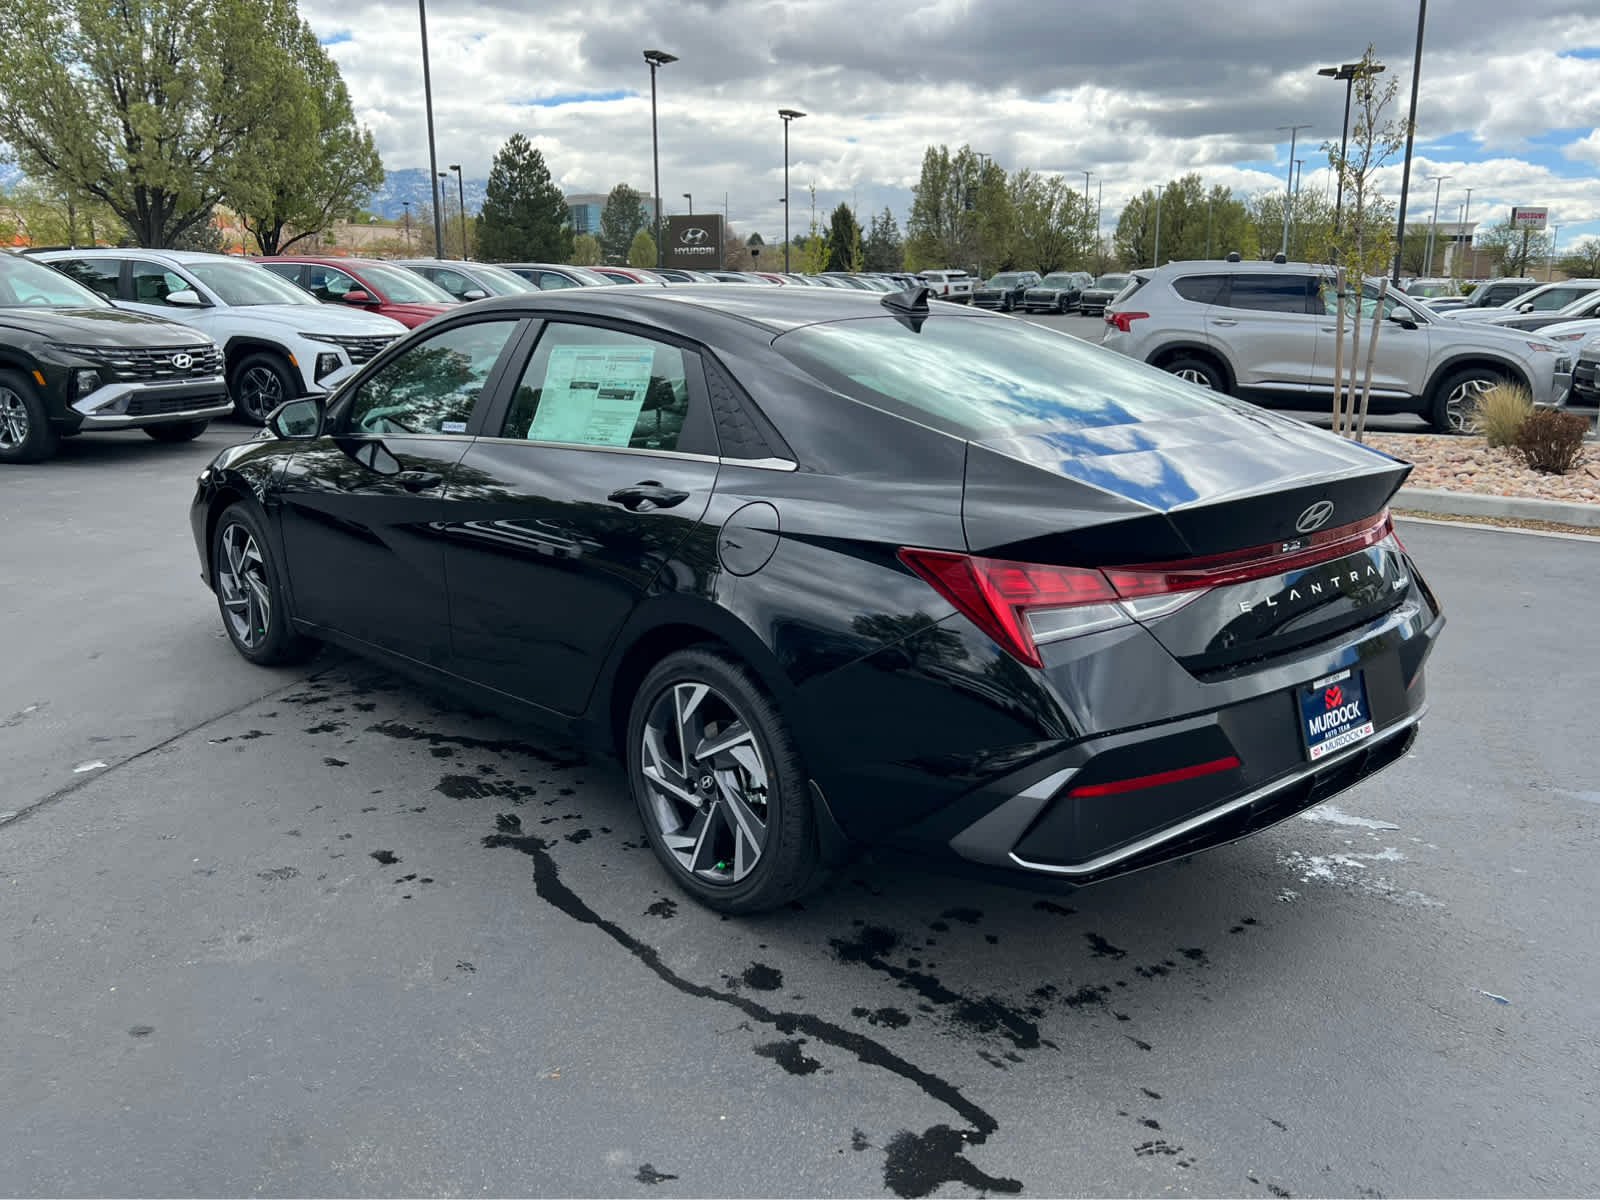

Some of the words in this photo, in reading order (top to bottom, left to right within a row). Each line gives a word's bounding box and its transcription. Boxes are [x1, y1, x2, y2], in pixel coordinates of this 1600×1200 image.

[674, 247, 715, 255] HYUNDAI
[1240, 566, 1376, 613] ELANTRA
[1309, 701, 1361, 736] MURDOCK
[1324, 729, 1338, 739] AUTO
[1338, 723, 1350, 734] TEAM
[1325, 730, 1360, 752] MURDOCK
